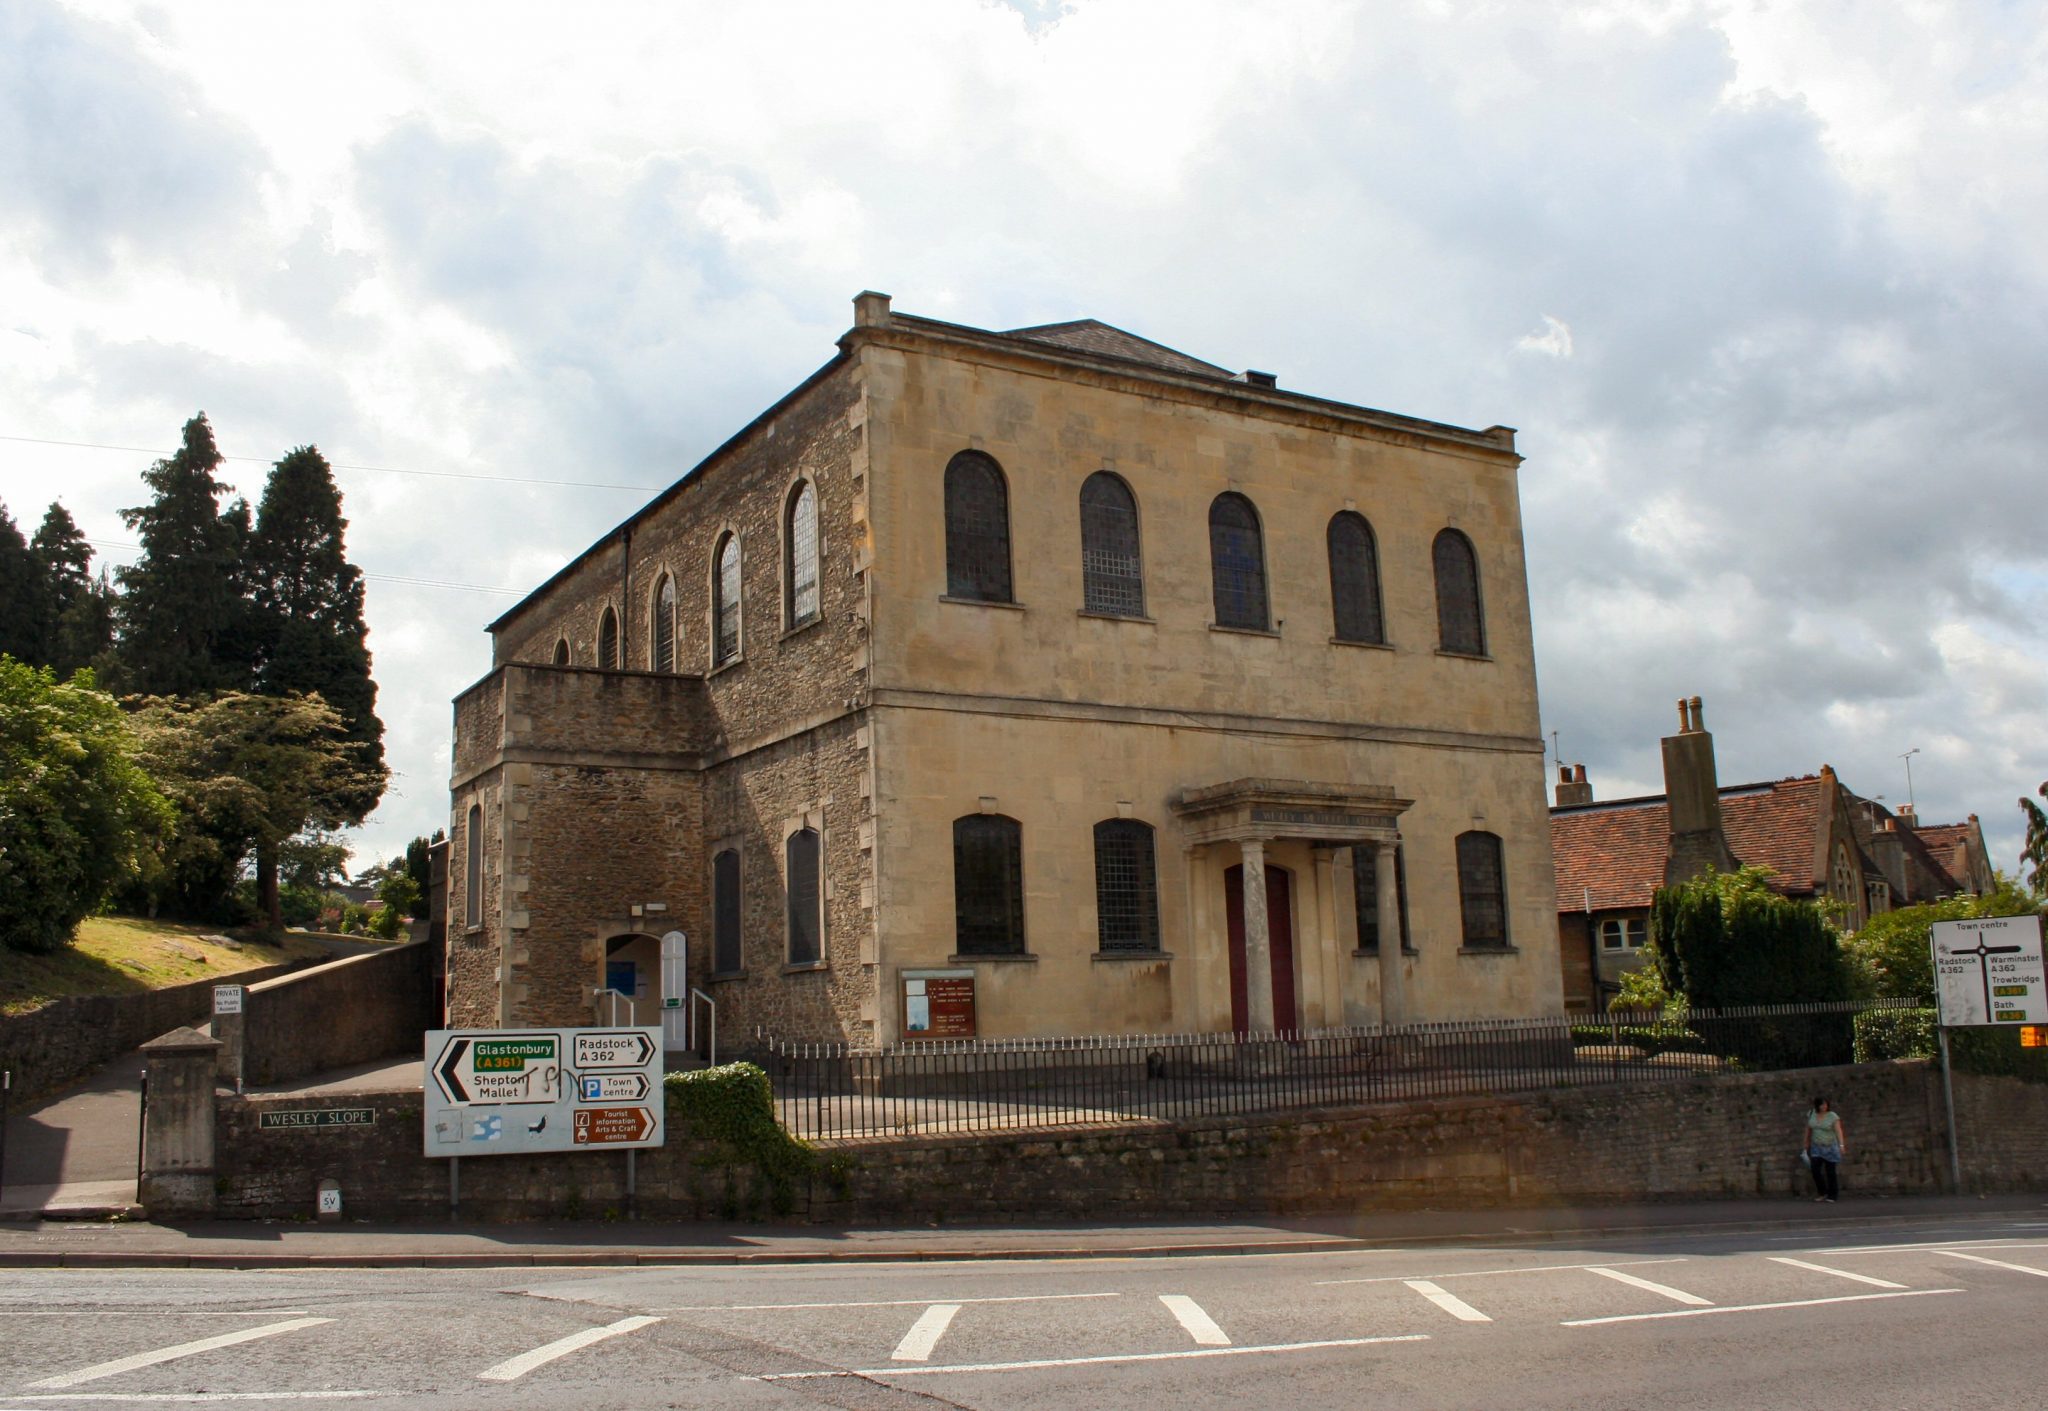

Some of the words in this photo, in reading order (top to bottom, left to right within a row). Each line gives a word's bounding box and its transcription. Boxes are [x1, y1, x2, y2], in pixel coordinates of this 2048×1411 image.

[1980, 921, 2008, 929] centre
[1938, 957, 1976, 965] Radstock
[1990, 955, 2039, 964] Warminster
[1992, 975, 2040, 984] Trowbridge
[1994, 1001, 2014, 1009] Bath
[579, 1039, 634, 1049] Radstock
[477, 1044, 552, 1057] Glastonbury
[476, 1057, 523, 1069] (A361)
[474, 1075, 525, 1087] Shepton
[607, 1078, 632, 1087] Town
[480, 1088, 518, 1098] Mallet
[603, 1088, 634, 1097] centre
[269, 1112, 320, 1125] WESLEY
[328, 1112, 367, 1123] SLOPE
[596, 1118, 636, 1126] information
[324, 1197, 336, 1205] SV
